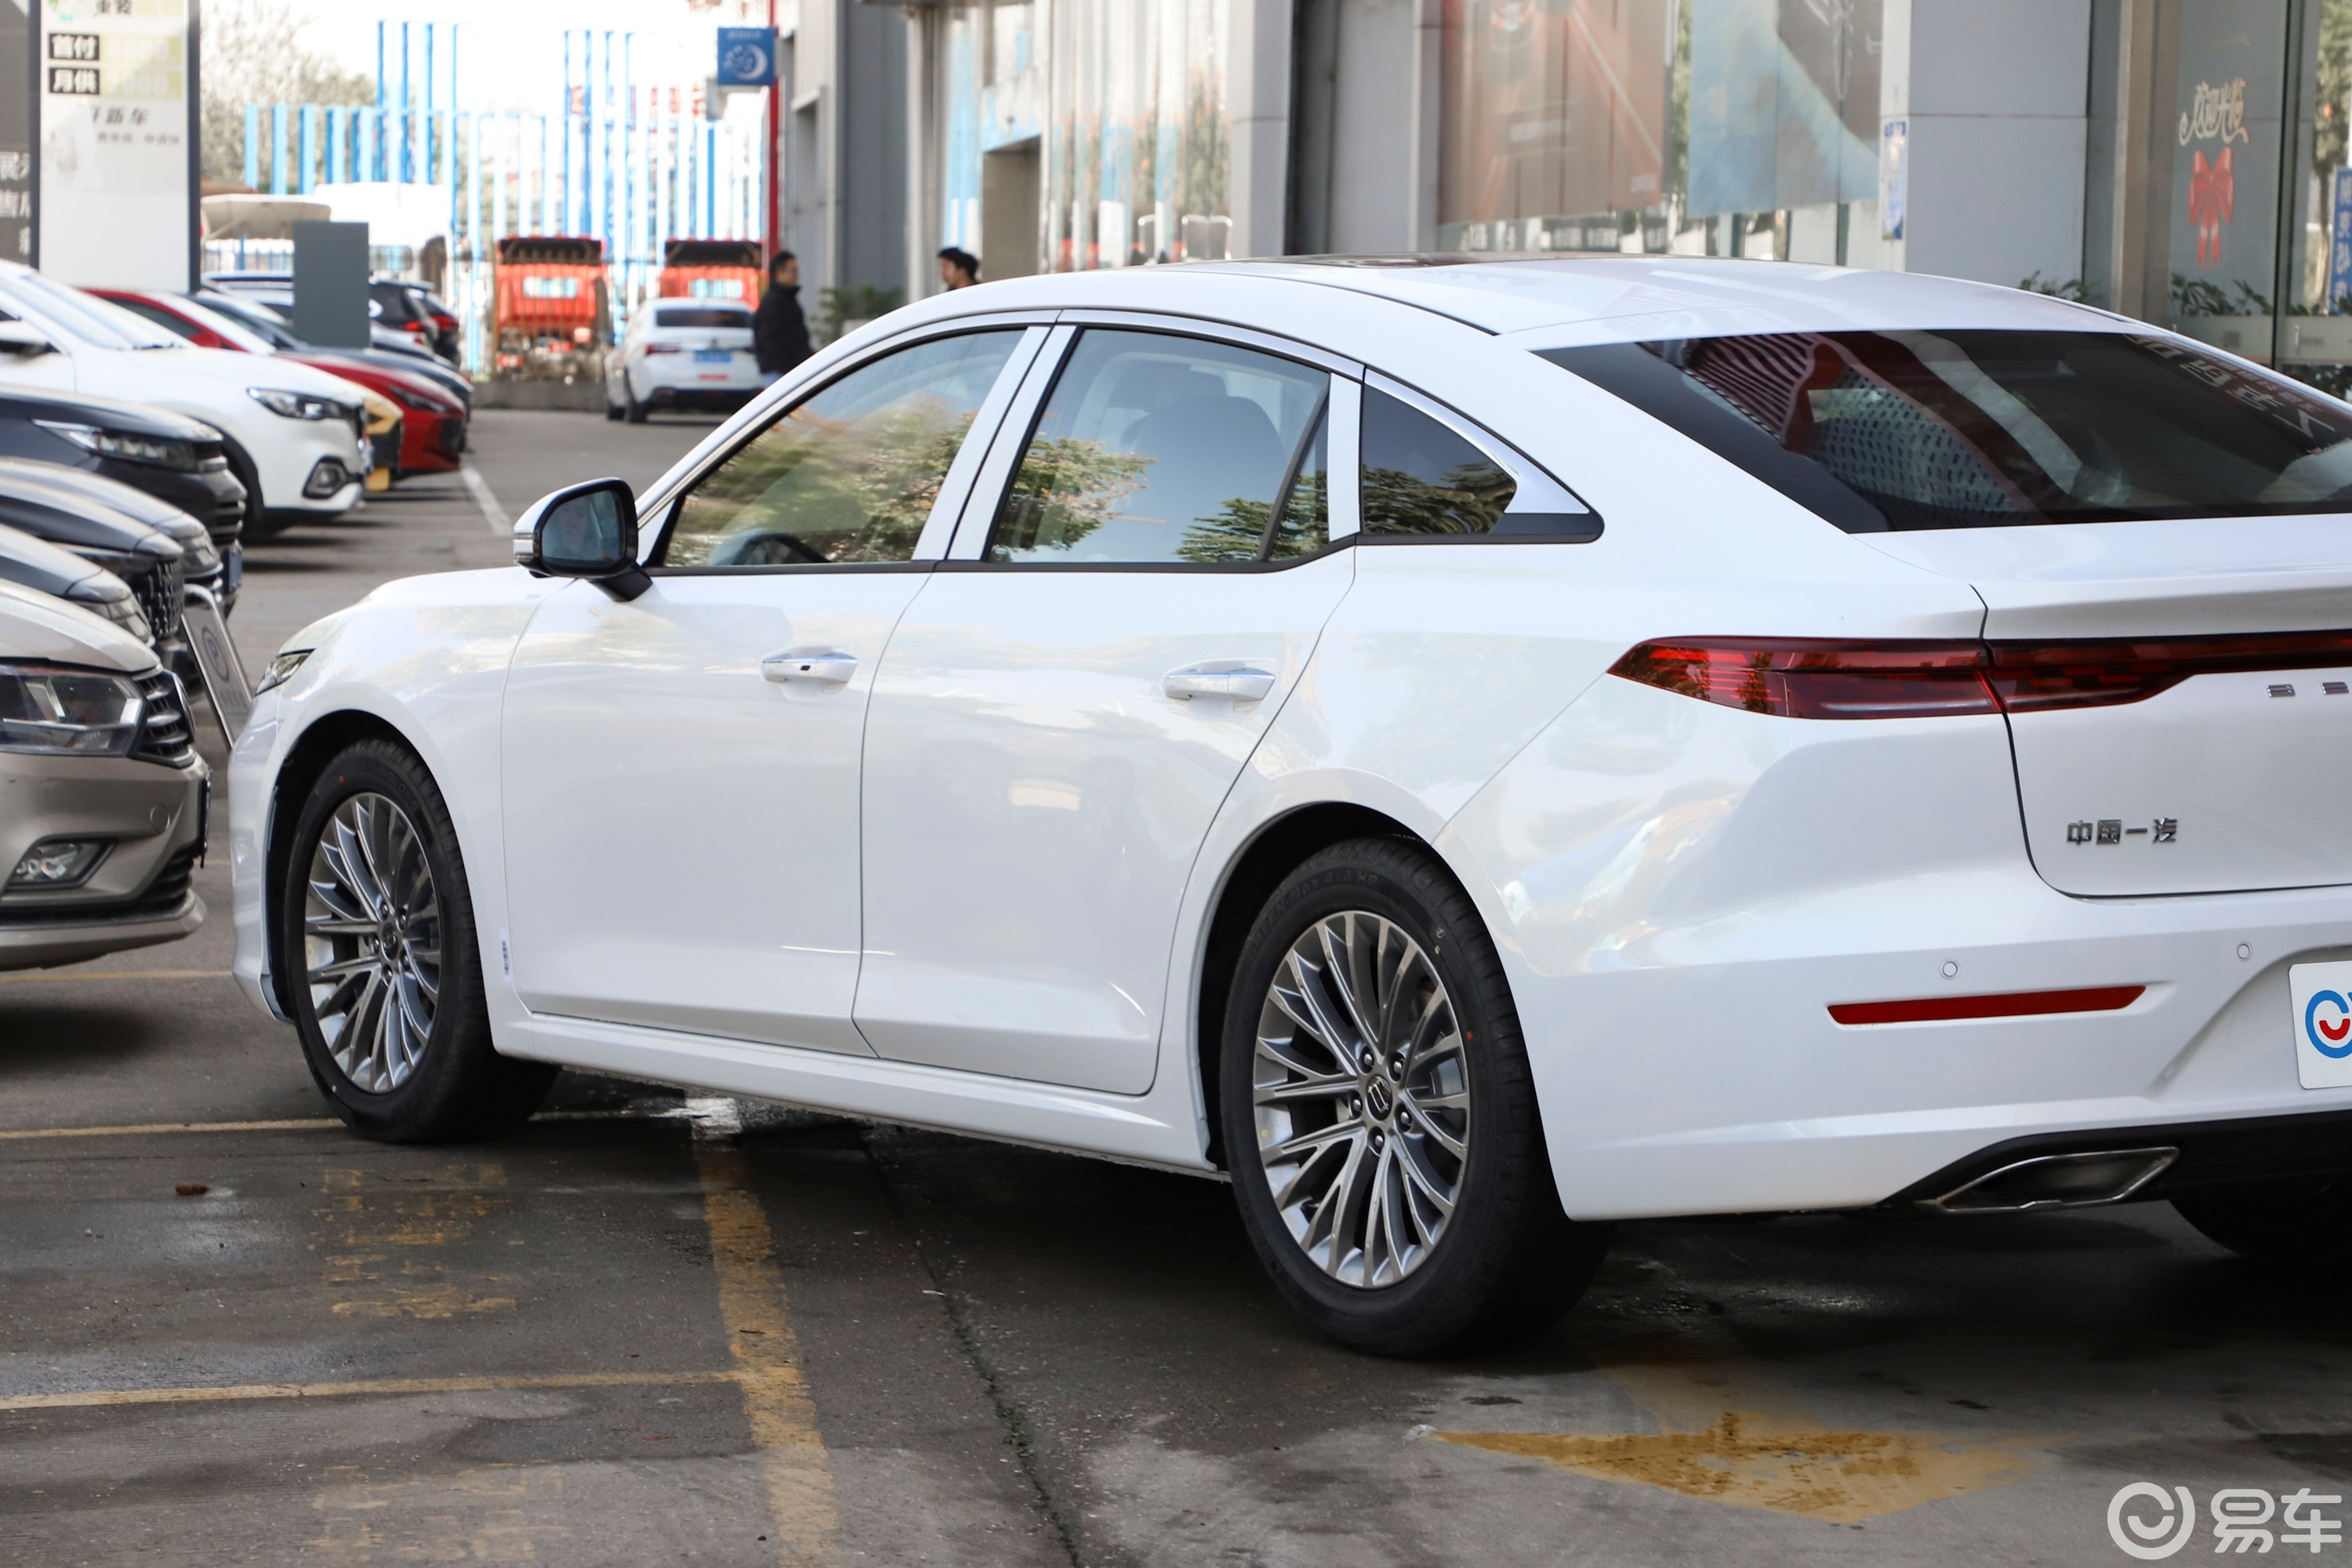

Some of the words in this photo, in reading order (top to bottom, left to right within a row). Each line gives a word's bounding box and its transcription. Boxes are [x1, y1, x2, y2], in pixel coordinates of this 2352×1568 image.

[2067, 818, 2178, 845] 中国一汽
[1357, 870, 1377, 887] HP
